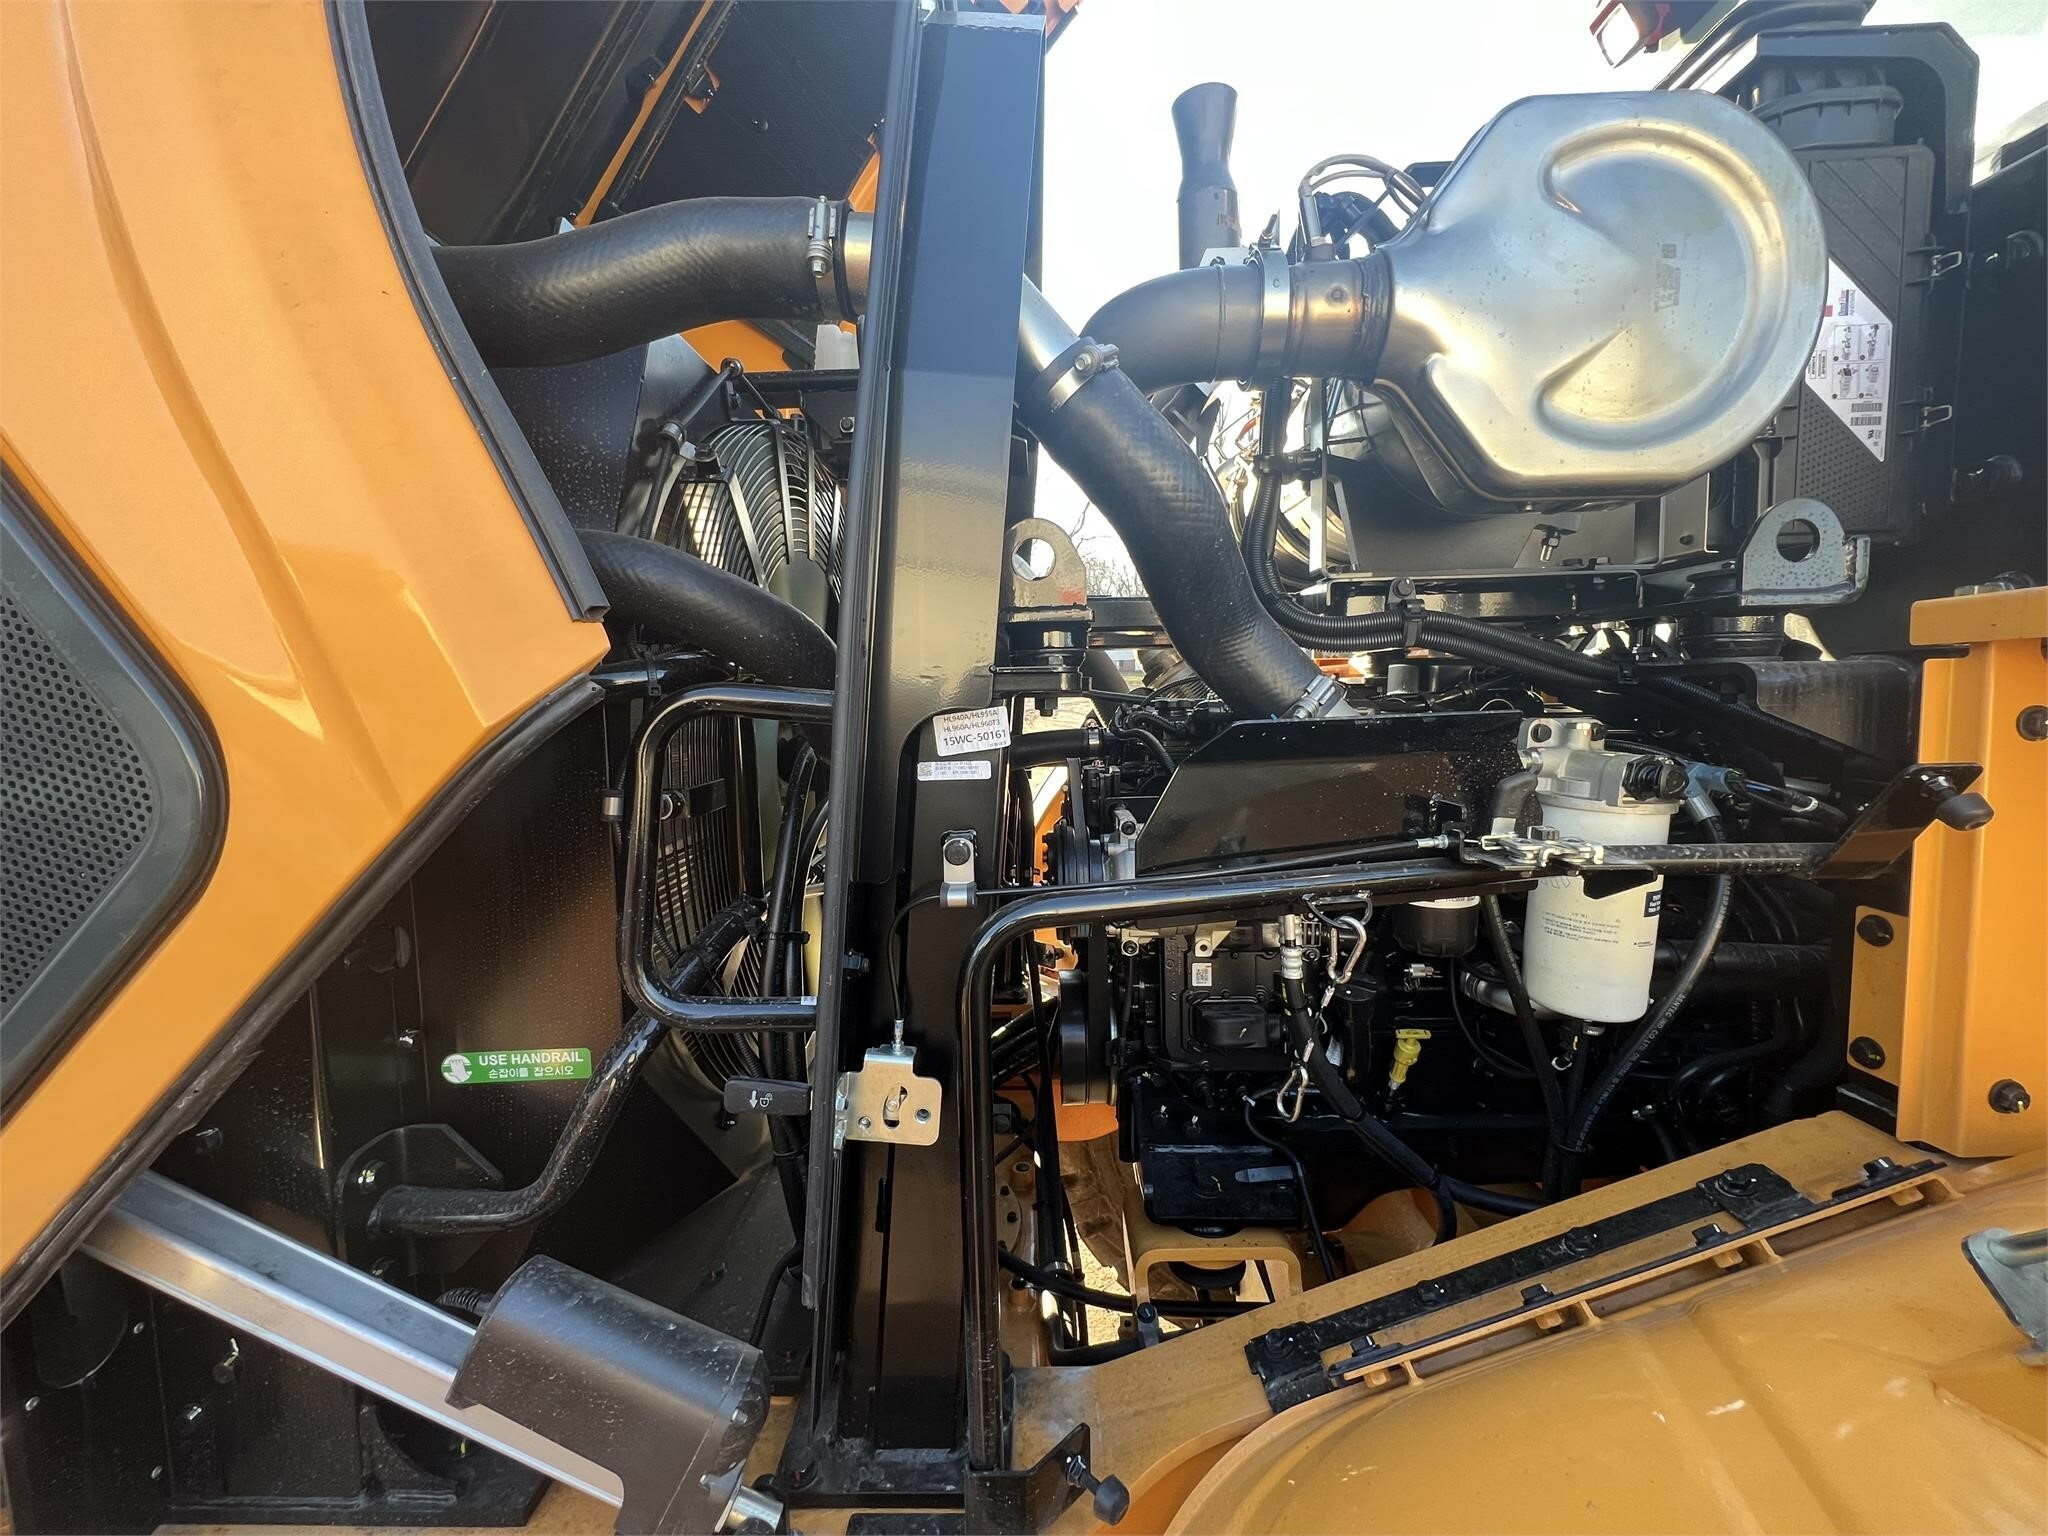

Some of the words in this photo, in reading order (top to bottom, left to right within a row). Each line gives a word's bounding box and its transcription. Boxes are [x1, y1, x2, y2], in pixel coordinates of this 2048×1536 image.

[944, 709, 998, 723] HL940A/HL955A
[944, 729, 1006, 746] 15WC-50161
[479, 1054, 507, 1066] USE
[511, 1051, 584, 1065] HANDRAIL
[488, 1067, 529, 1079] 손잡이를
[533, 1065, 574, 1077] 잡으시오
